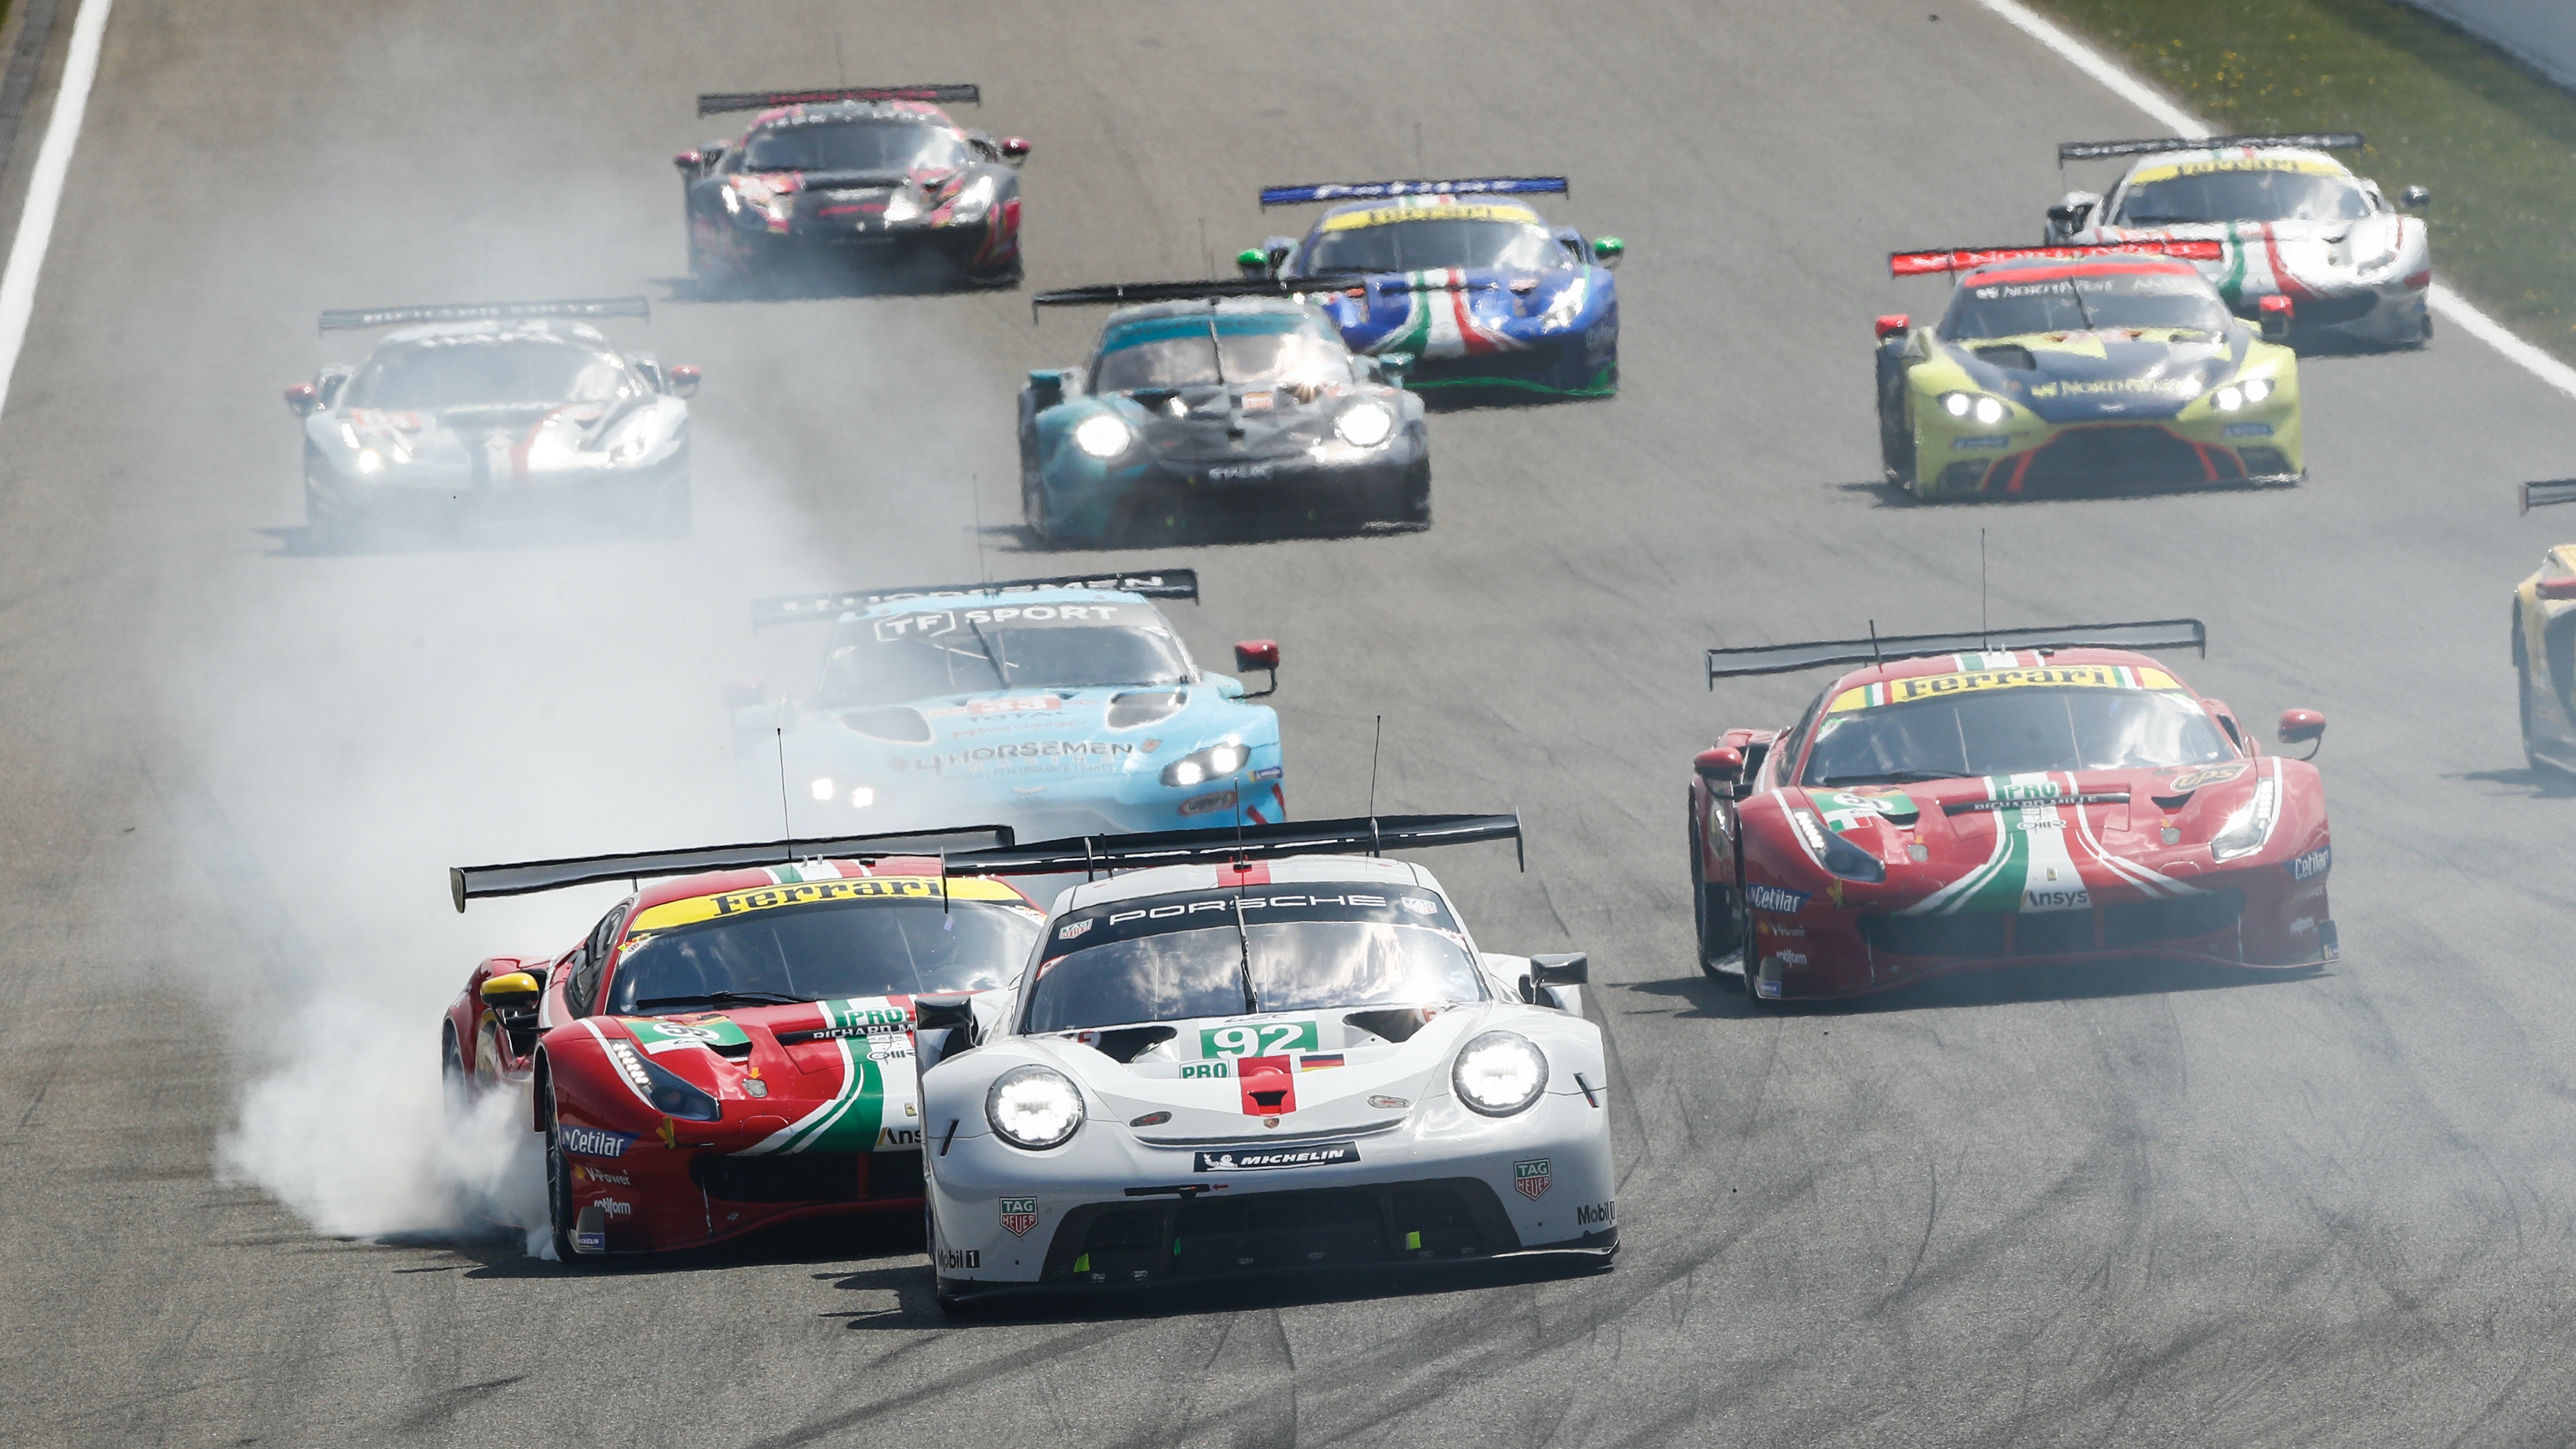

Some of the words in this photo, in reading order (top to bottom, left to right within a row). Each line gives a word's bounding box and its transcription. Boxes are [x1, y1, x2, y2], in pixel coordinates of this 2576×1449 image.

[886, 615, 942, 634] TF
[965, 605, 1118, 624] SPORT
[1899, 667, 2108, 700] Ferrari
[2007, 784, 2057, 799] PRO
[2295, 850, 2329, 880] Cetilar
[711, 880, 946, 916] Ferrari
[1755, 886, 1801, 913] Cetilar
[2021, 889, 2088, 907] Ansys
[1109, 894, 1387, 925] PORSCHE
[847, 1008, 903, 1025] PRO
[1213, 1024, 1307, 1060] 92
[1182, 1063, 1227, 1079] PRO
[570, 1129, 624, 1157] Cetilar
[876, 1127, 922, 1146] Ans
[1241, 1150, 1344, 1165] MICHELIN
[1518, 1163, 1548, 1176] TAG
[1518, 1177, 1549, 1197] HEUER
[1003, 1201, 1033, 1212] TAG
[1577, 1201, 1609, 1225] Mobil
[1003, 1215, 1035, 1232] HEUER
